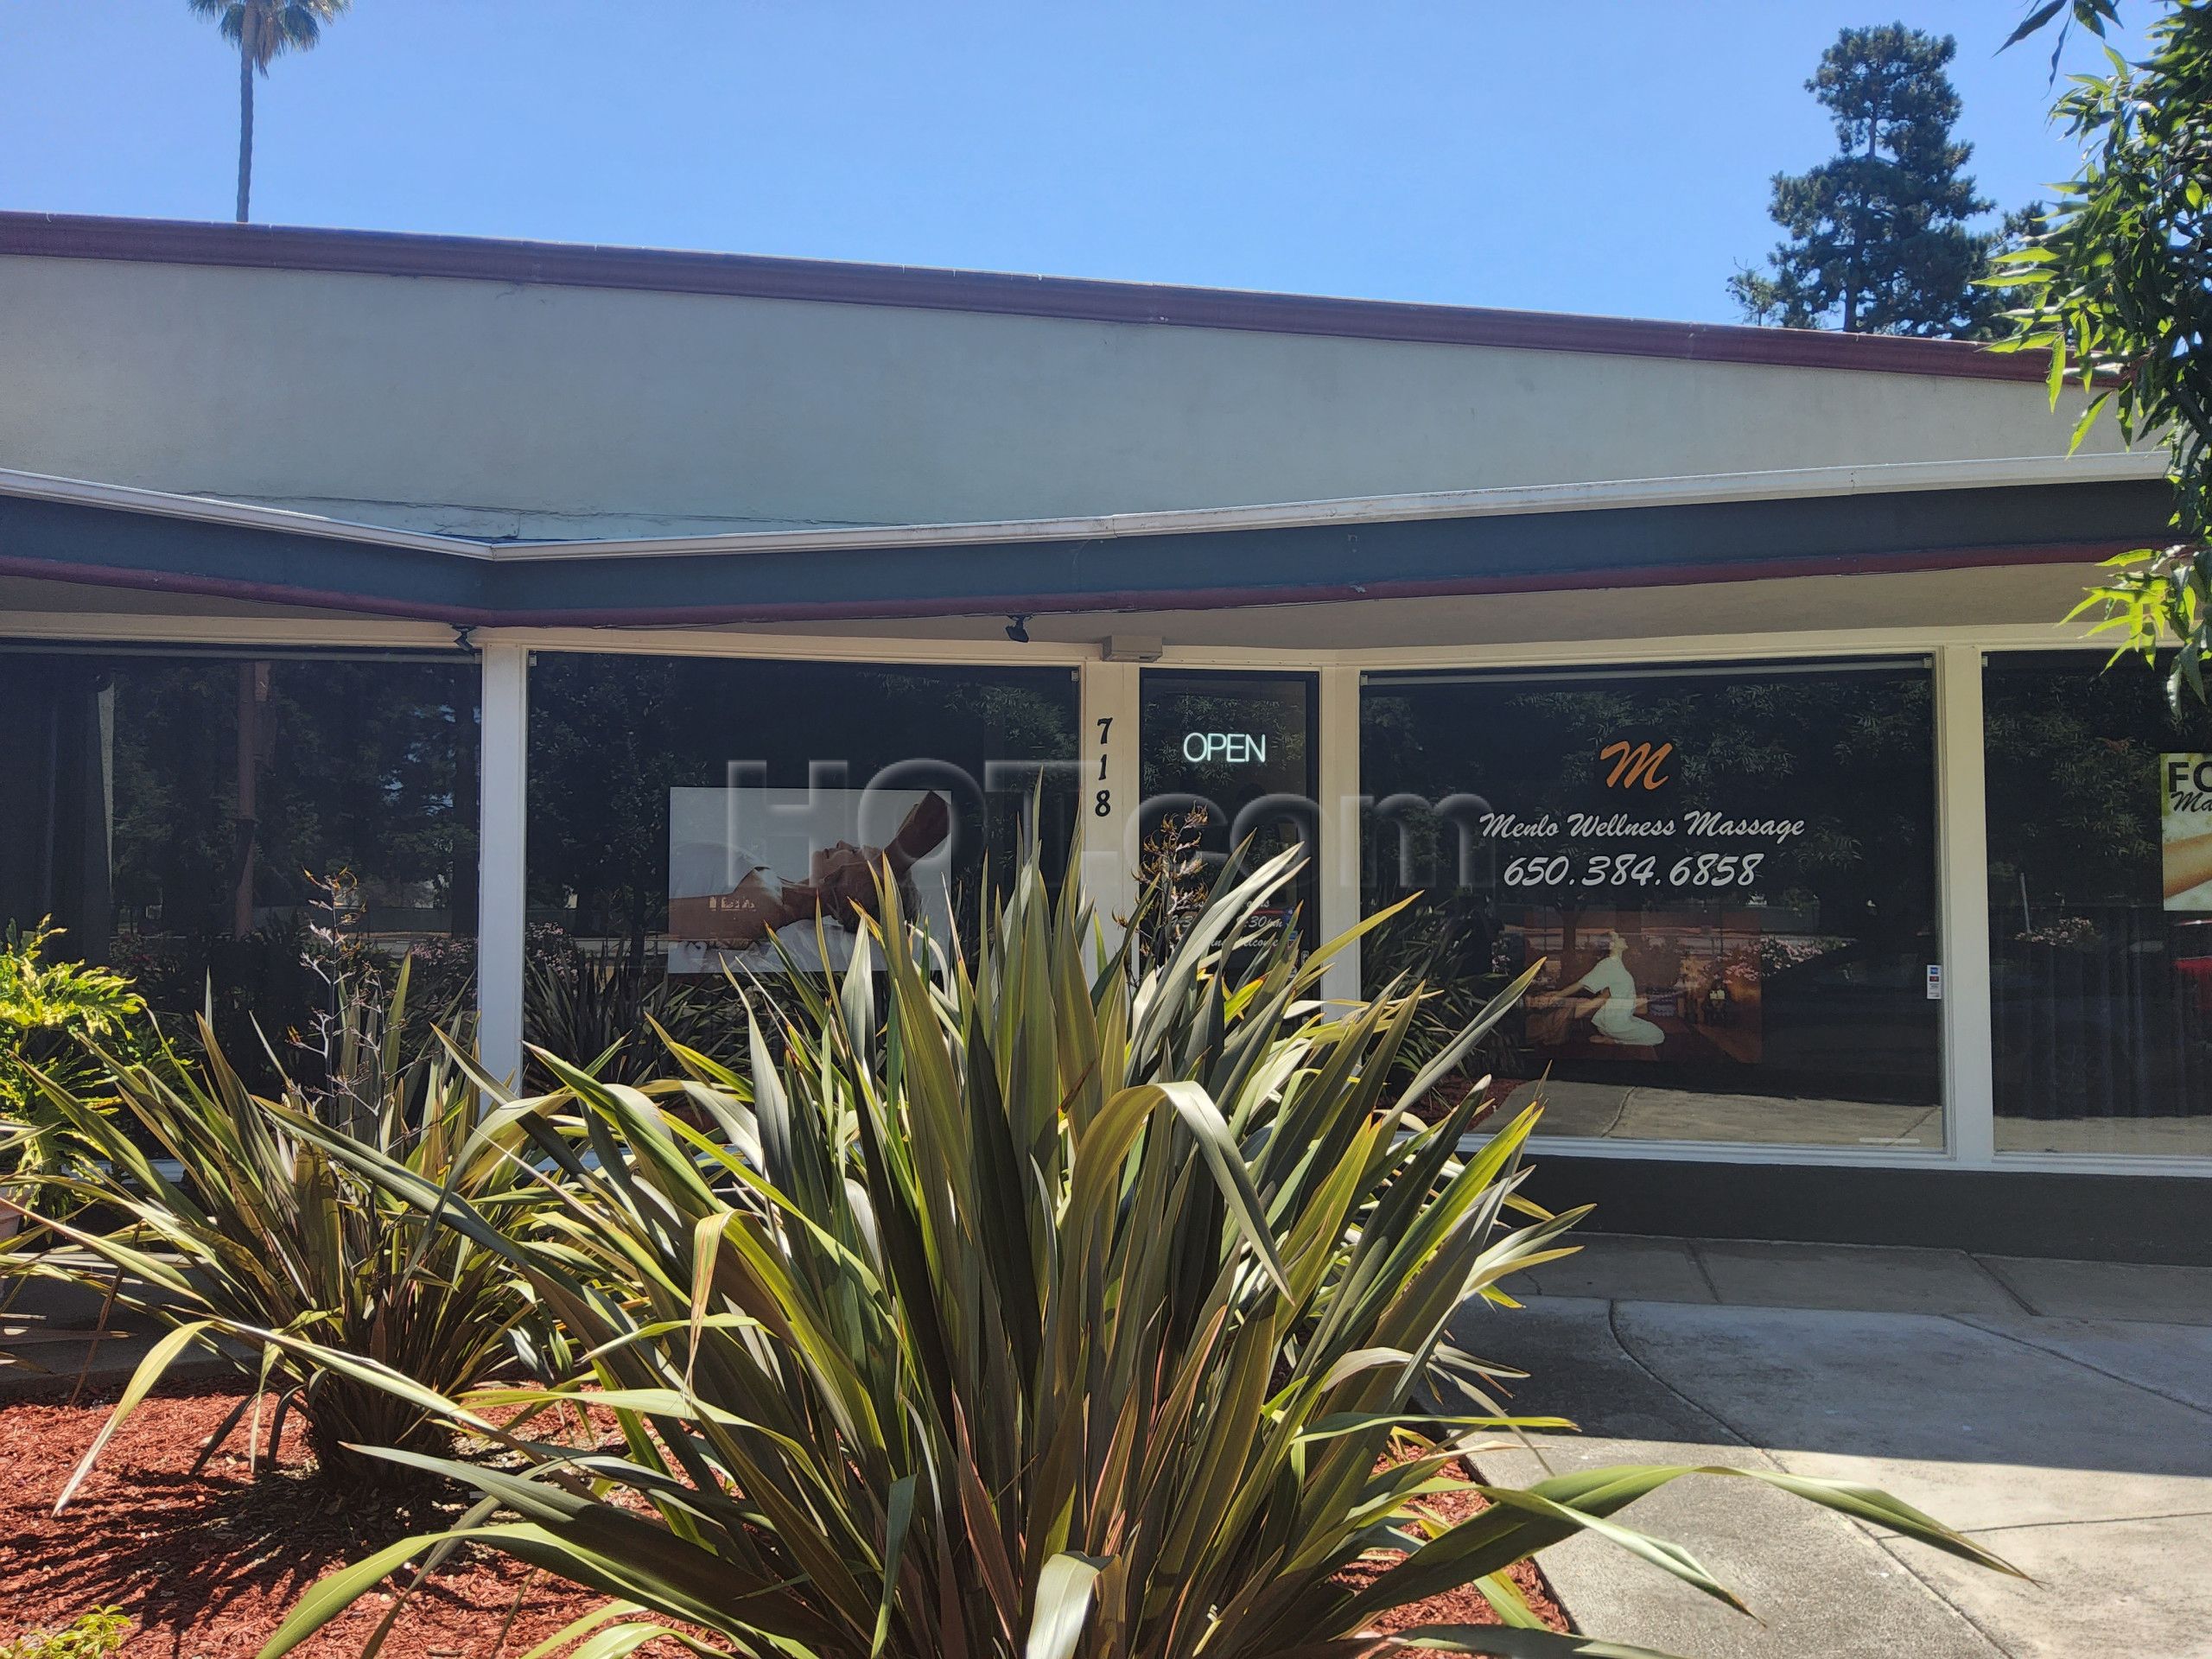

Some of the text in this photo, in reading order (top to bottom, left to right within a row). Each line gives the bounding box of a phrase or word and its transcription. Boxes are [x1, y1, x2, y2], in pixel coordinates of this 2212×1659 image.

[1182, 732, 1266, 763] OPEN
[1095, 716, 1114, 817] 718
[1599, 741, 1674, 791] M
[1479, 810, 1805, 844] Menlo Wellness Massage
[1503, 853, 1765, 887] 650.384.6858
